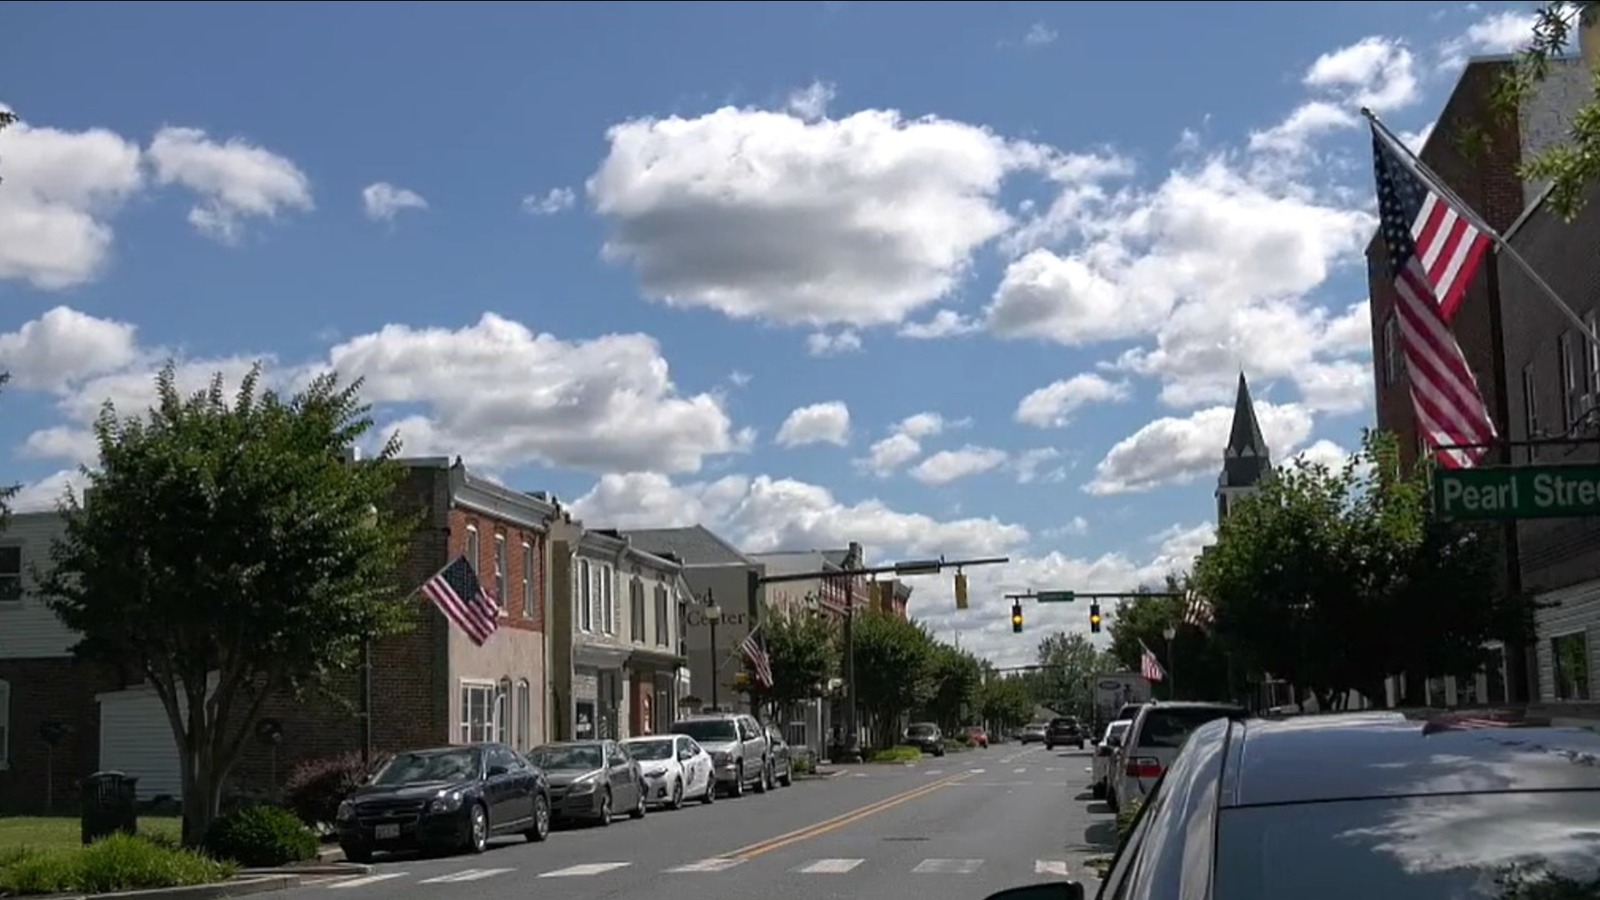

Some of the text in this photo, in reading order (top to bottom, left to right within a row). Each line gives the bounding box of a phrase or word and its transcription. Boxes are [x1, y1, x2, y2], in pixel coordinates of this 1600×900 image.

[1443, 473, 1600, 510] Pearl Stre
[687, 610, 746, 626] Ceter
